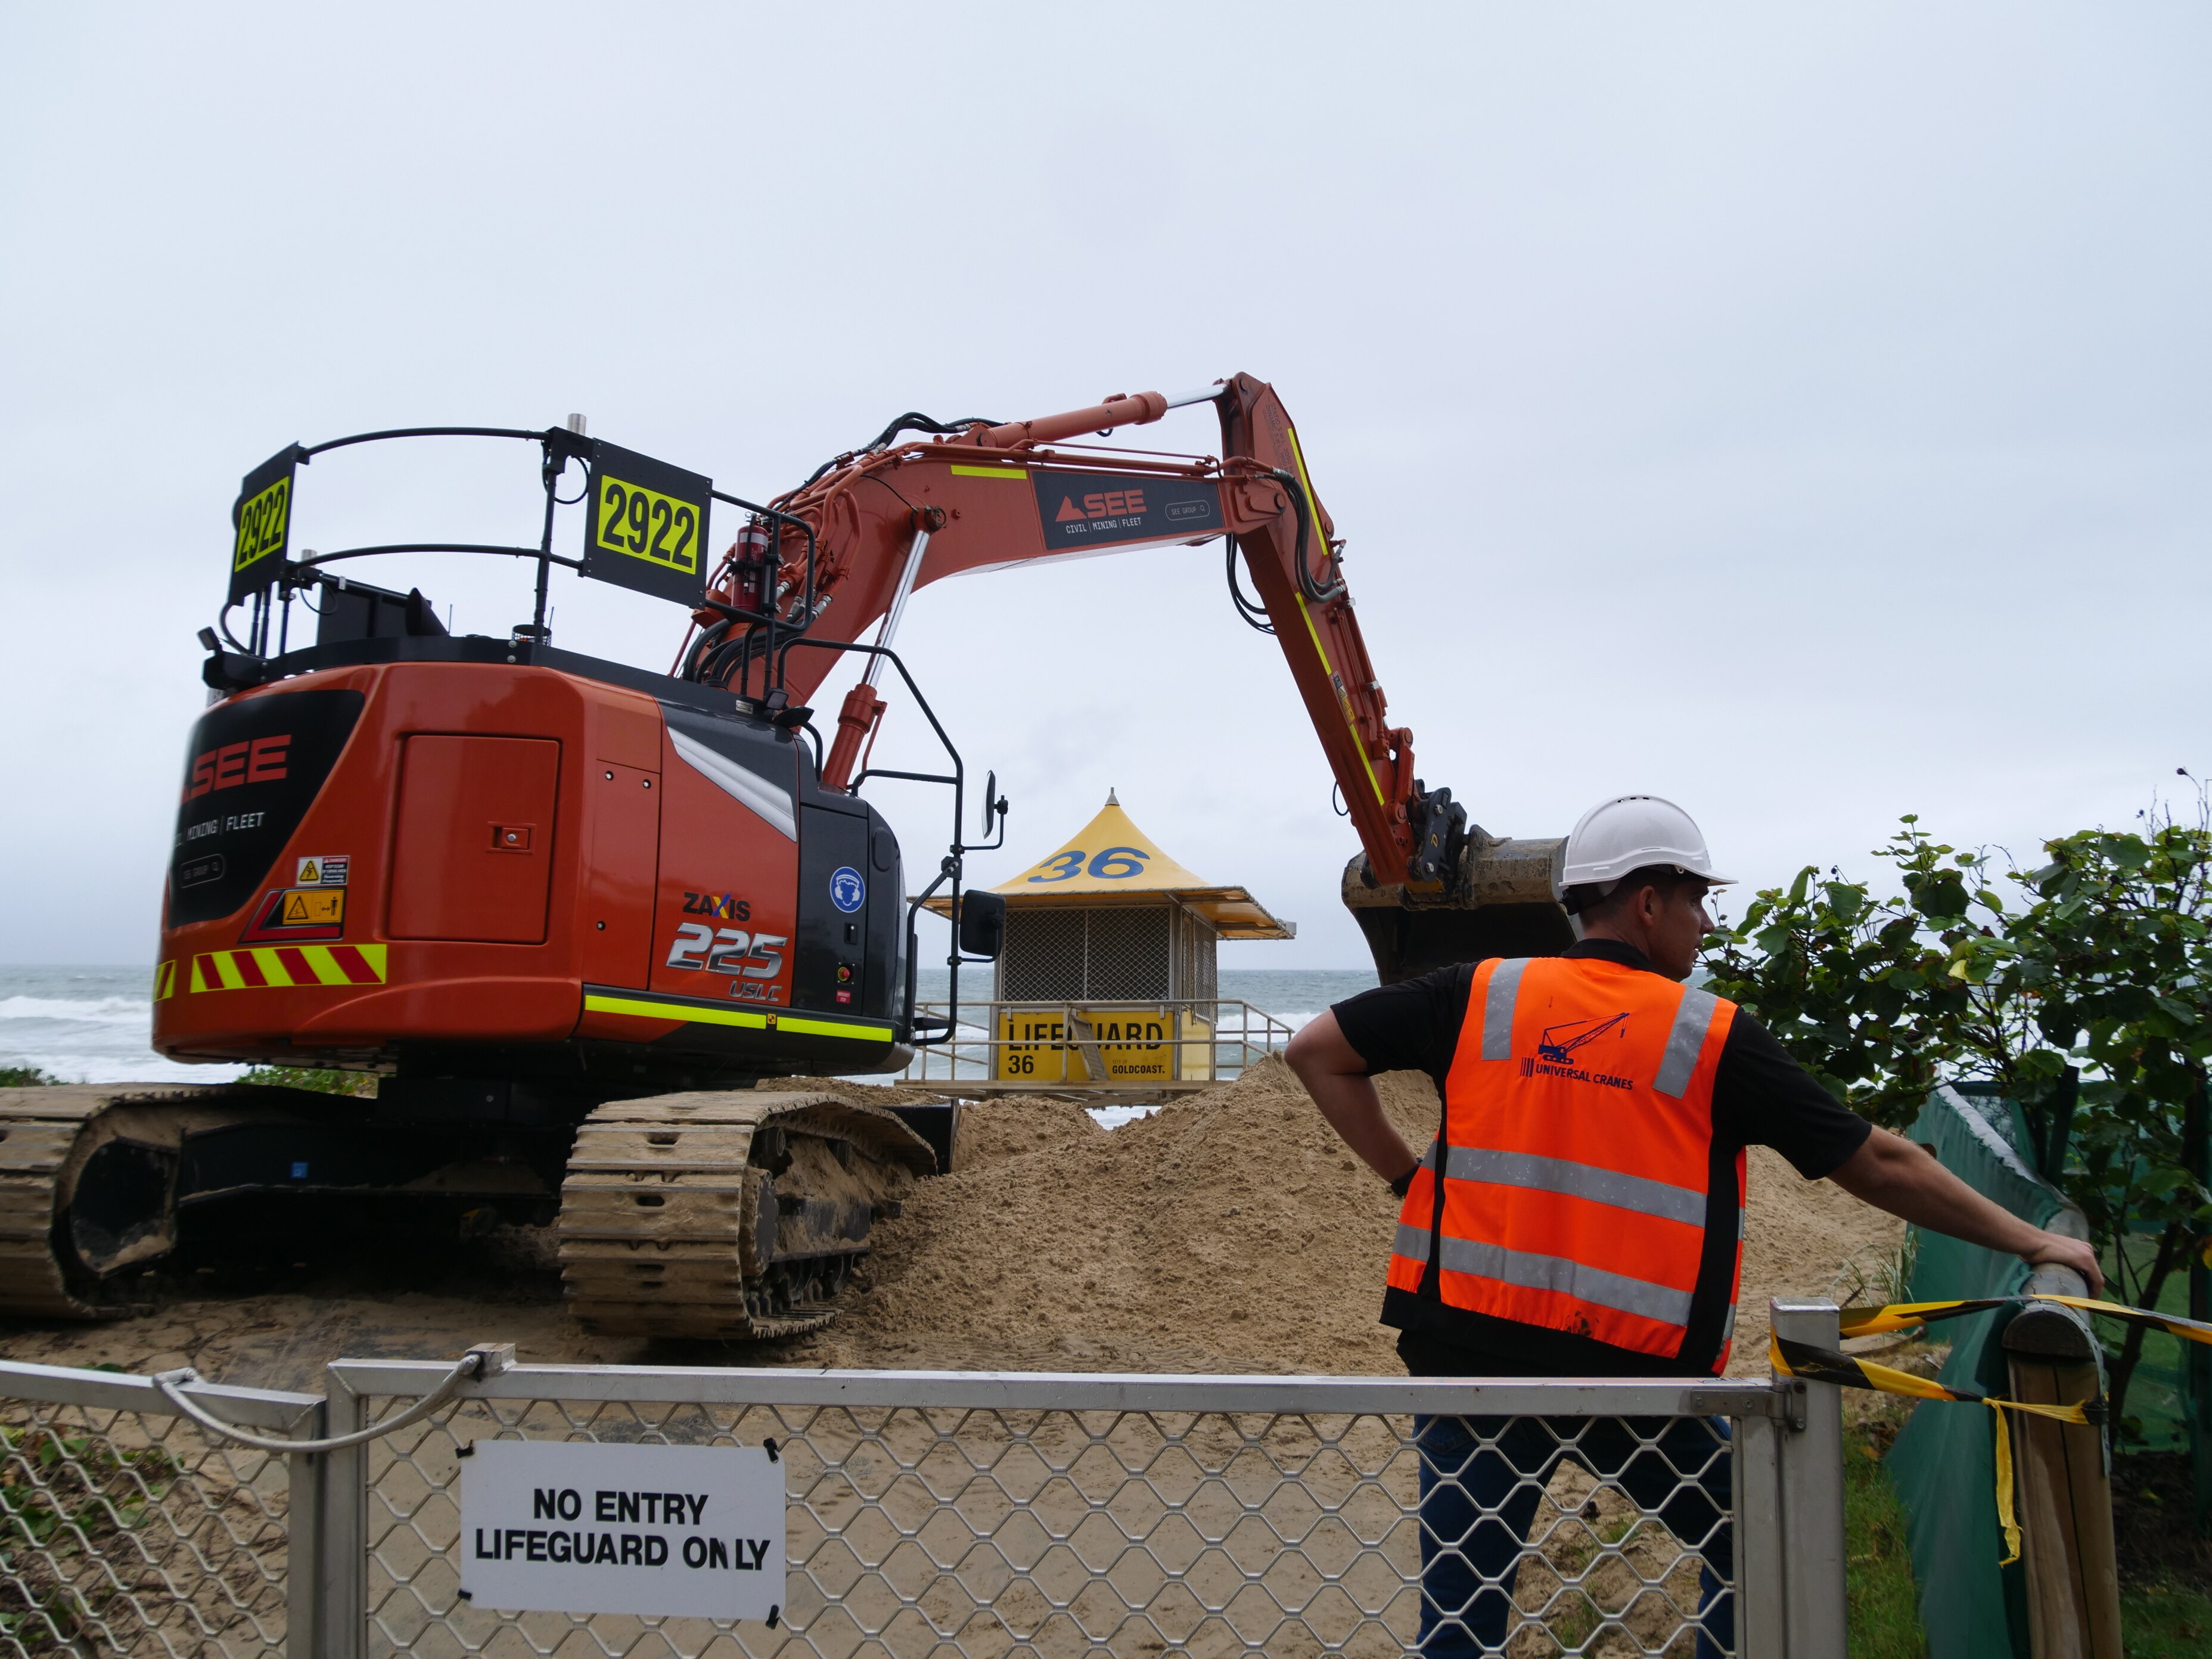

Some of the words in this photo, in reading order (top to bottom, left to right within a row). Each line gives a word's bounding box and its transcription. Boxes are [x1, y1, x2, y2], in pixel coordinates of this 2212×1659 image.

[1083, 489, 1147, 518] SEE
[237, 484, 285, 566] 2922
[604, 483, 695, 568] 2922
[1065, 523, 1087, 534] CIVIL
[1092, 520, 1117, 531] MINING
[1122, 517, 1142, 527] FLEET
[189, 734, 292, 800] SEE
[187, 819, 219, 841] MINING
[226, 811, 266, 831] FLEET
[1027, 847, 1150, 883] 36
[683, 892, 750, 921] ZAXIS
[666, 922, 789, 980] 225
[729, 980, 782, 1002] USLC
[1008, 1055, 1034, 1074] 36
[1536, 1063, 1590, 1082] UNIVERSAL
[1593, 1073, 1634, 1090] CRANES
[534, 1489, 582, 1521] NO
[596, 1491, 709, 1525] ENTRY
[476, 1528, 668, 1567] LIFEGUARD
[682, 1536, 771, 1571] ONLY
